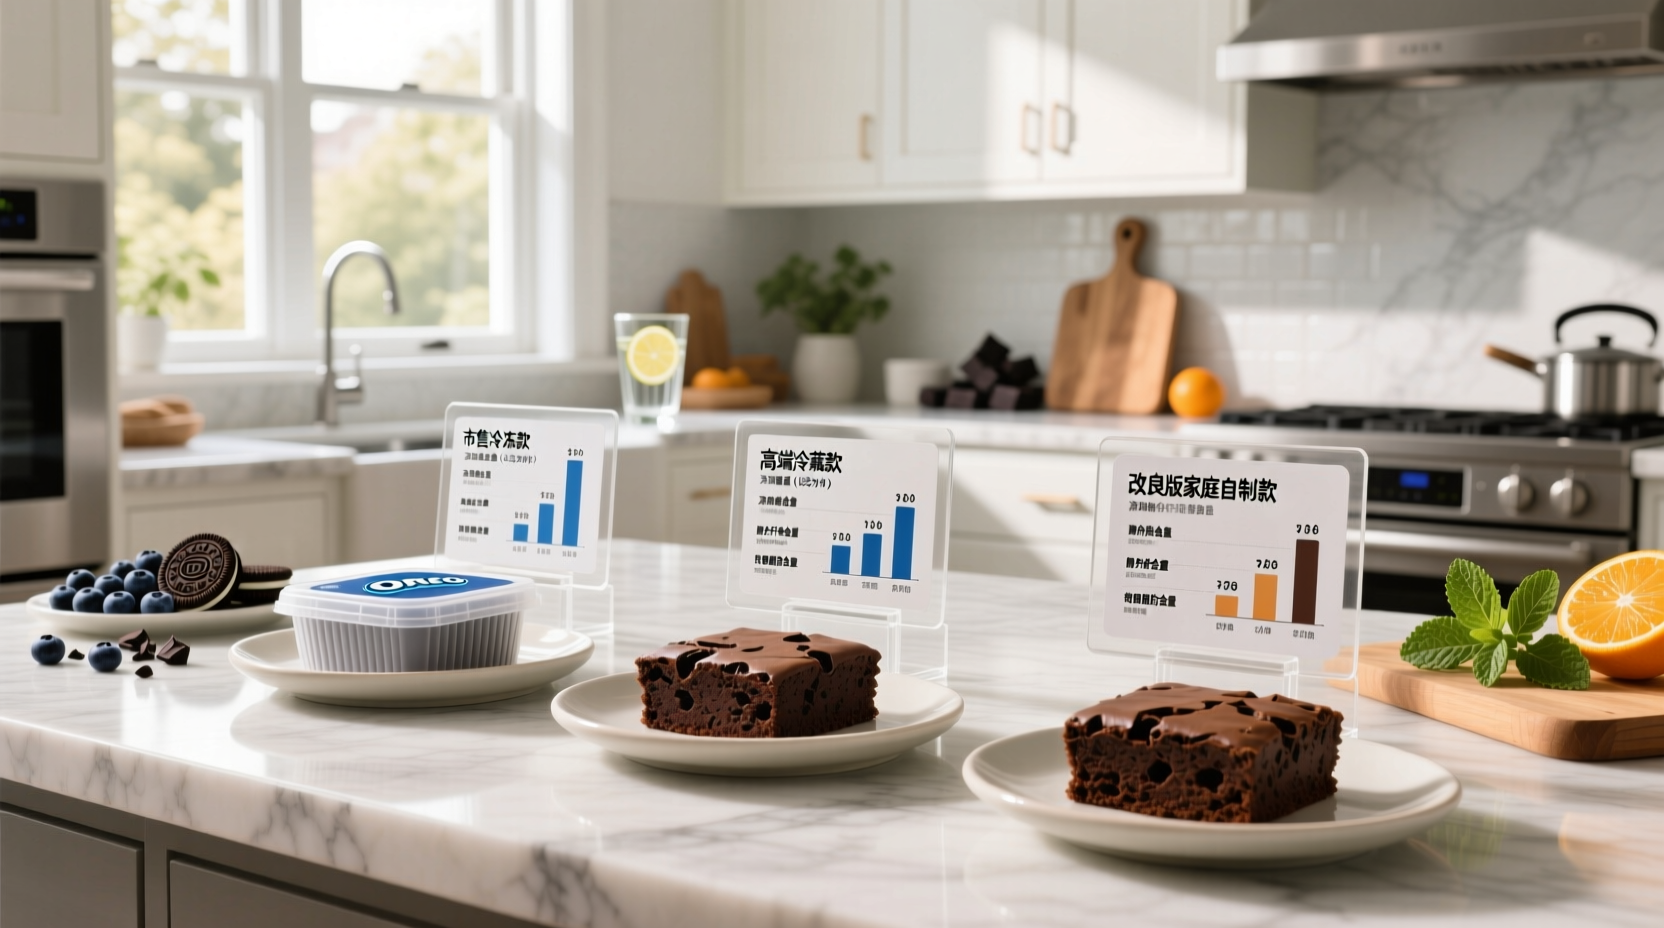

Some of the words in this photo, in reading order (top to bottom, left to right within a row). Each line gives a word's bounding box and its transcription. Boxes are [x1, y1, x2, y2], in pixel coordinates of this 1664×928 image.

[1128, 472, 1278, 503] 改良版家庭自制款
